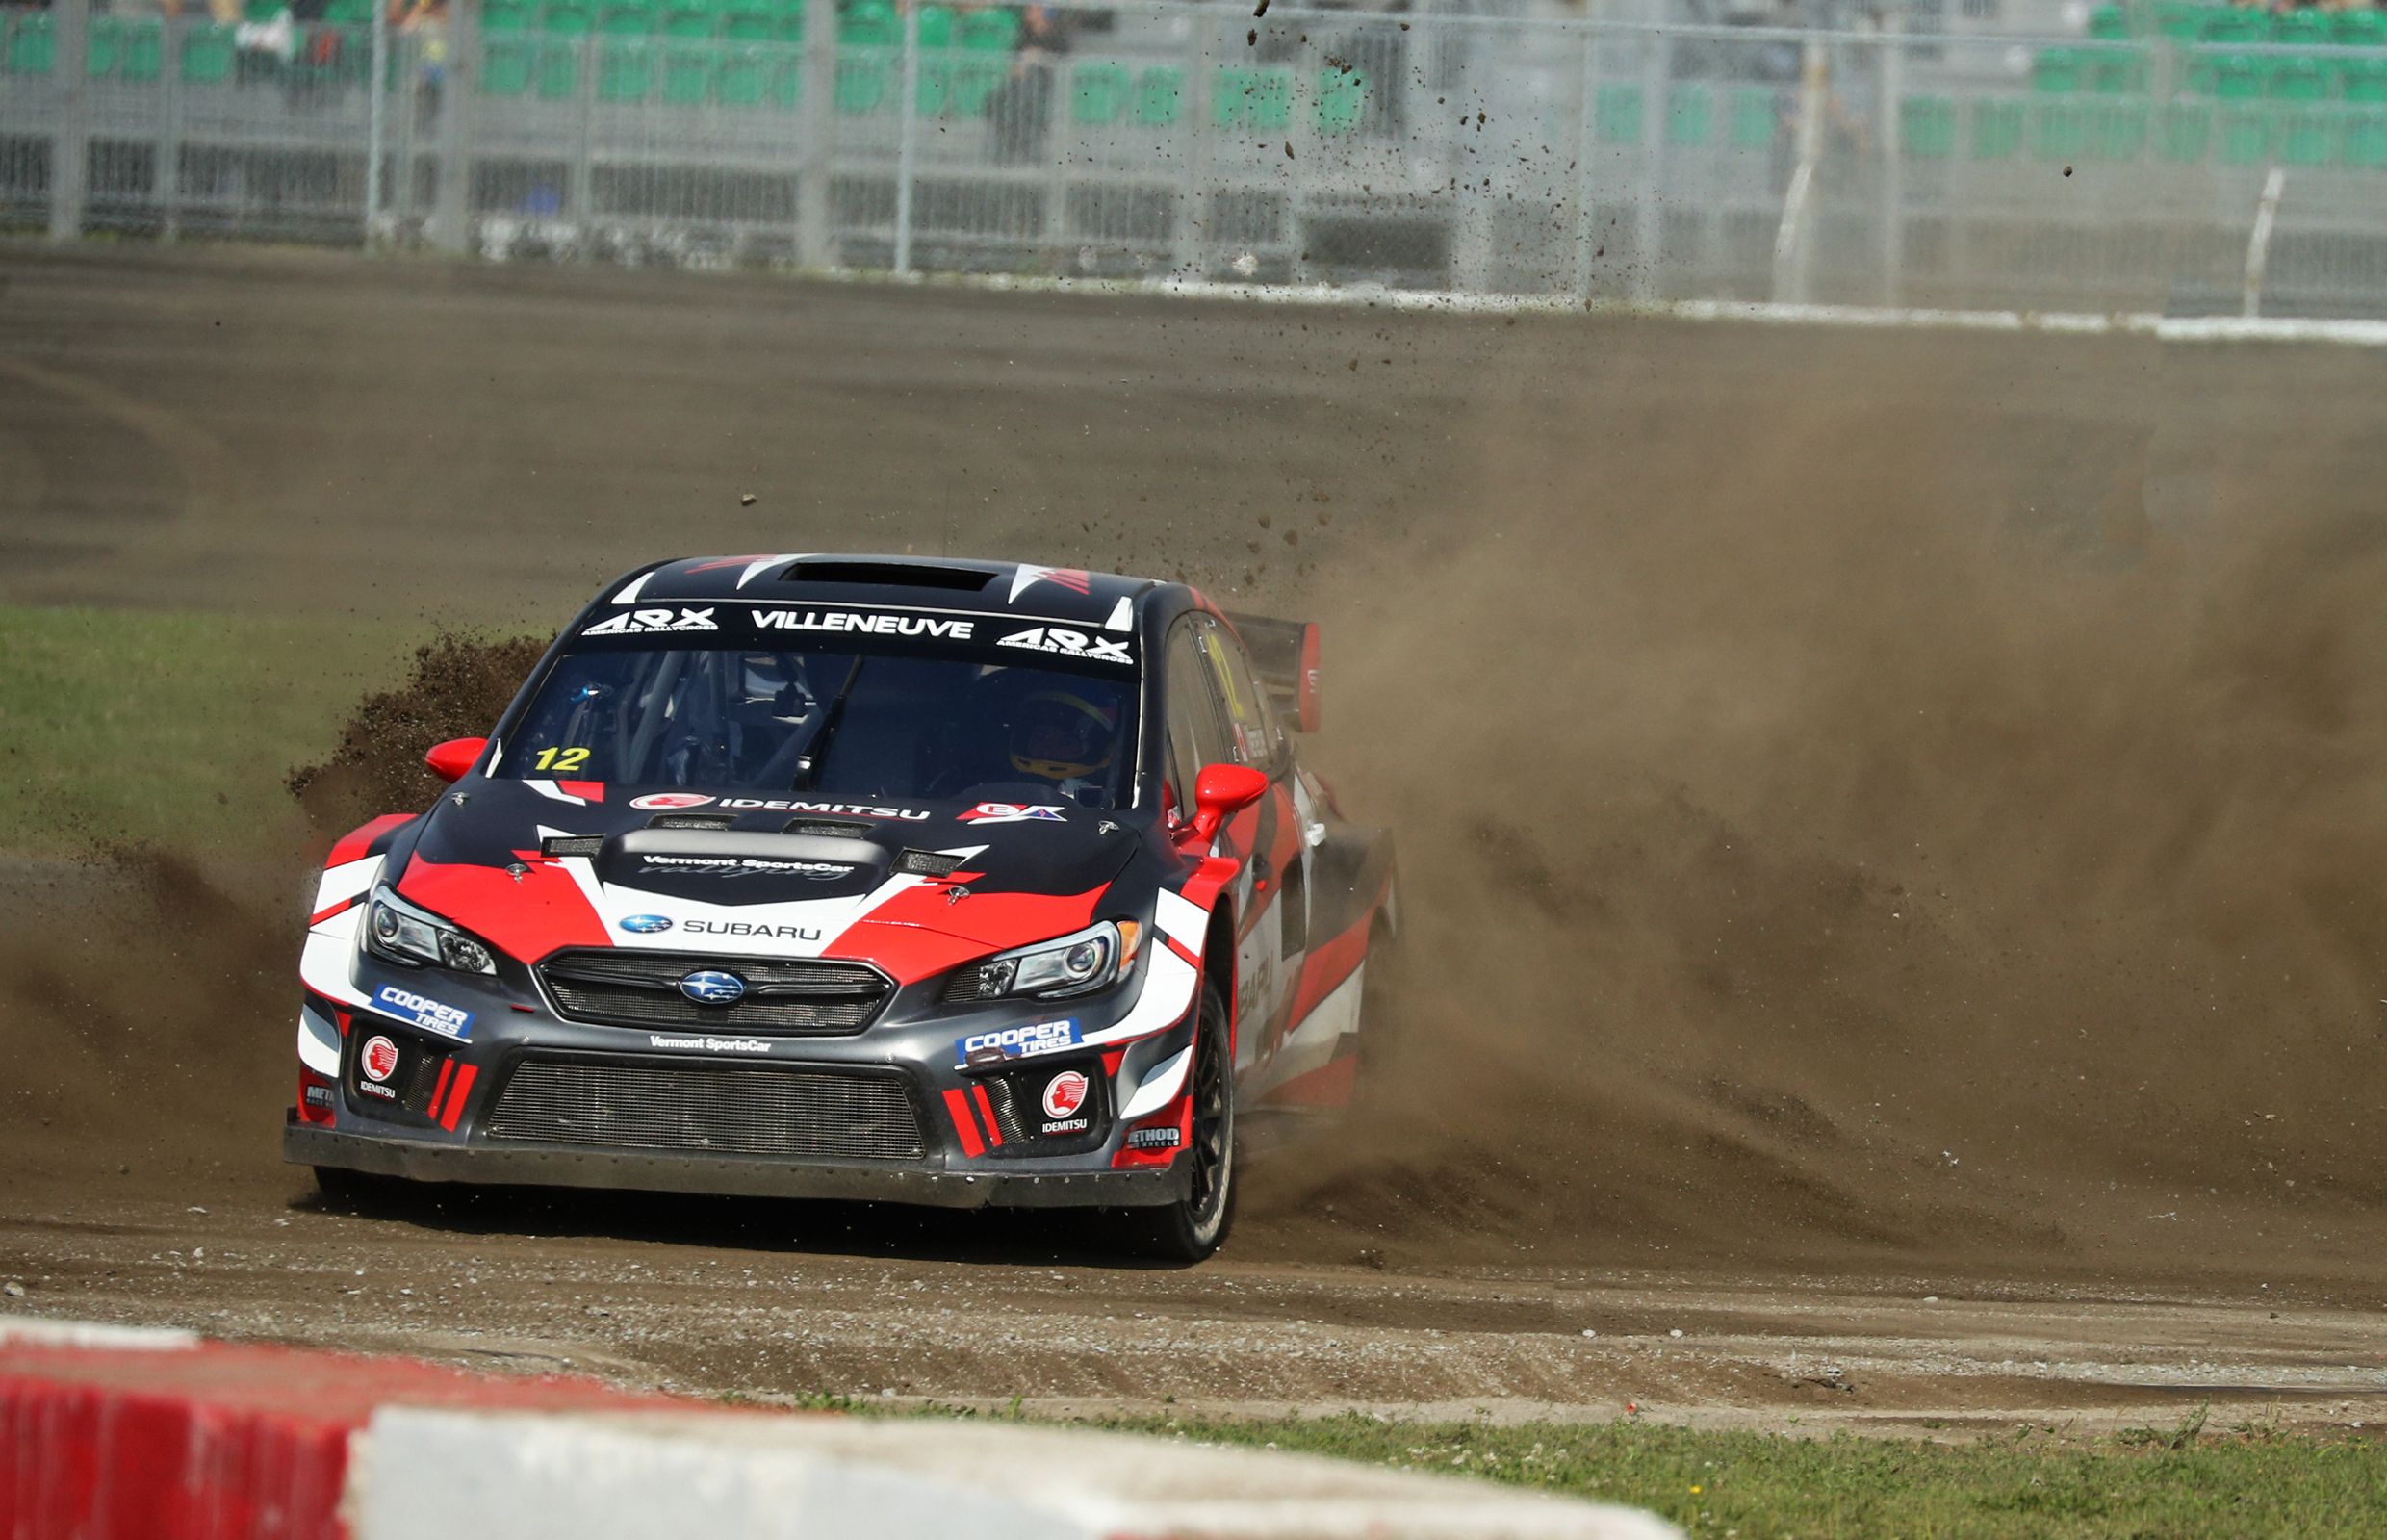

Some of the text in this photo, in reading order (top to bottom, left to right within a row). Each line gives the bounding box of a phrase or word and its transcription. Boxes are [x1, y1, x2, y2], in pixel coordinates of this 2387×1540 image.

[586, 607, 715, 630] ARX
[751, 609, 974, 639] VILLENEUVE
[581, 624, 719, 636] AMERICAS RALLYCROSS
[996, 639, 1134, 665] AMERICAS RALLYCROSS
[999, 627, 1129, 659] ARX
[535, 747, 591, 771] 12
[719, 798, 931, 820] IDEMITSU
[643, 855, 855, 872] Vermont SportsCar
[682, 920, 821, 940] SUBARU
[380, 987, 468, 1026] COOPER
[416, 1012, 461, 1036] TIRES
[650, 1035, 771, 1053] Vermont SportsCar
[964, 1019, 1071, 1052] COOPER
[1018, 1037, 1072, 1052] TIRES
[360, 1080, 396, 1099] IDEMITSU
[1042, 1118, 1088, 1134] IDEMITSU
